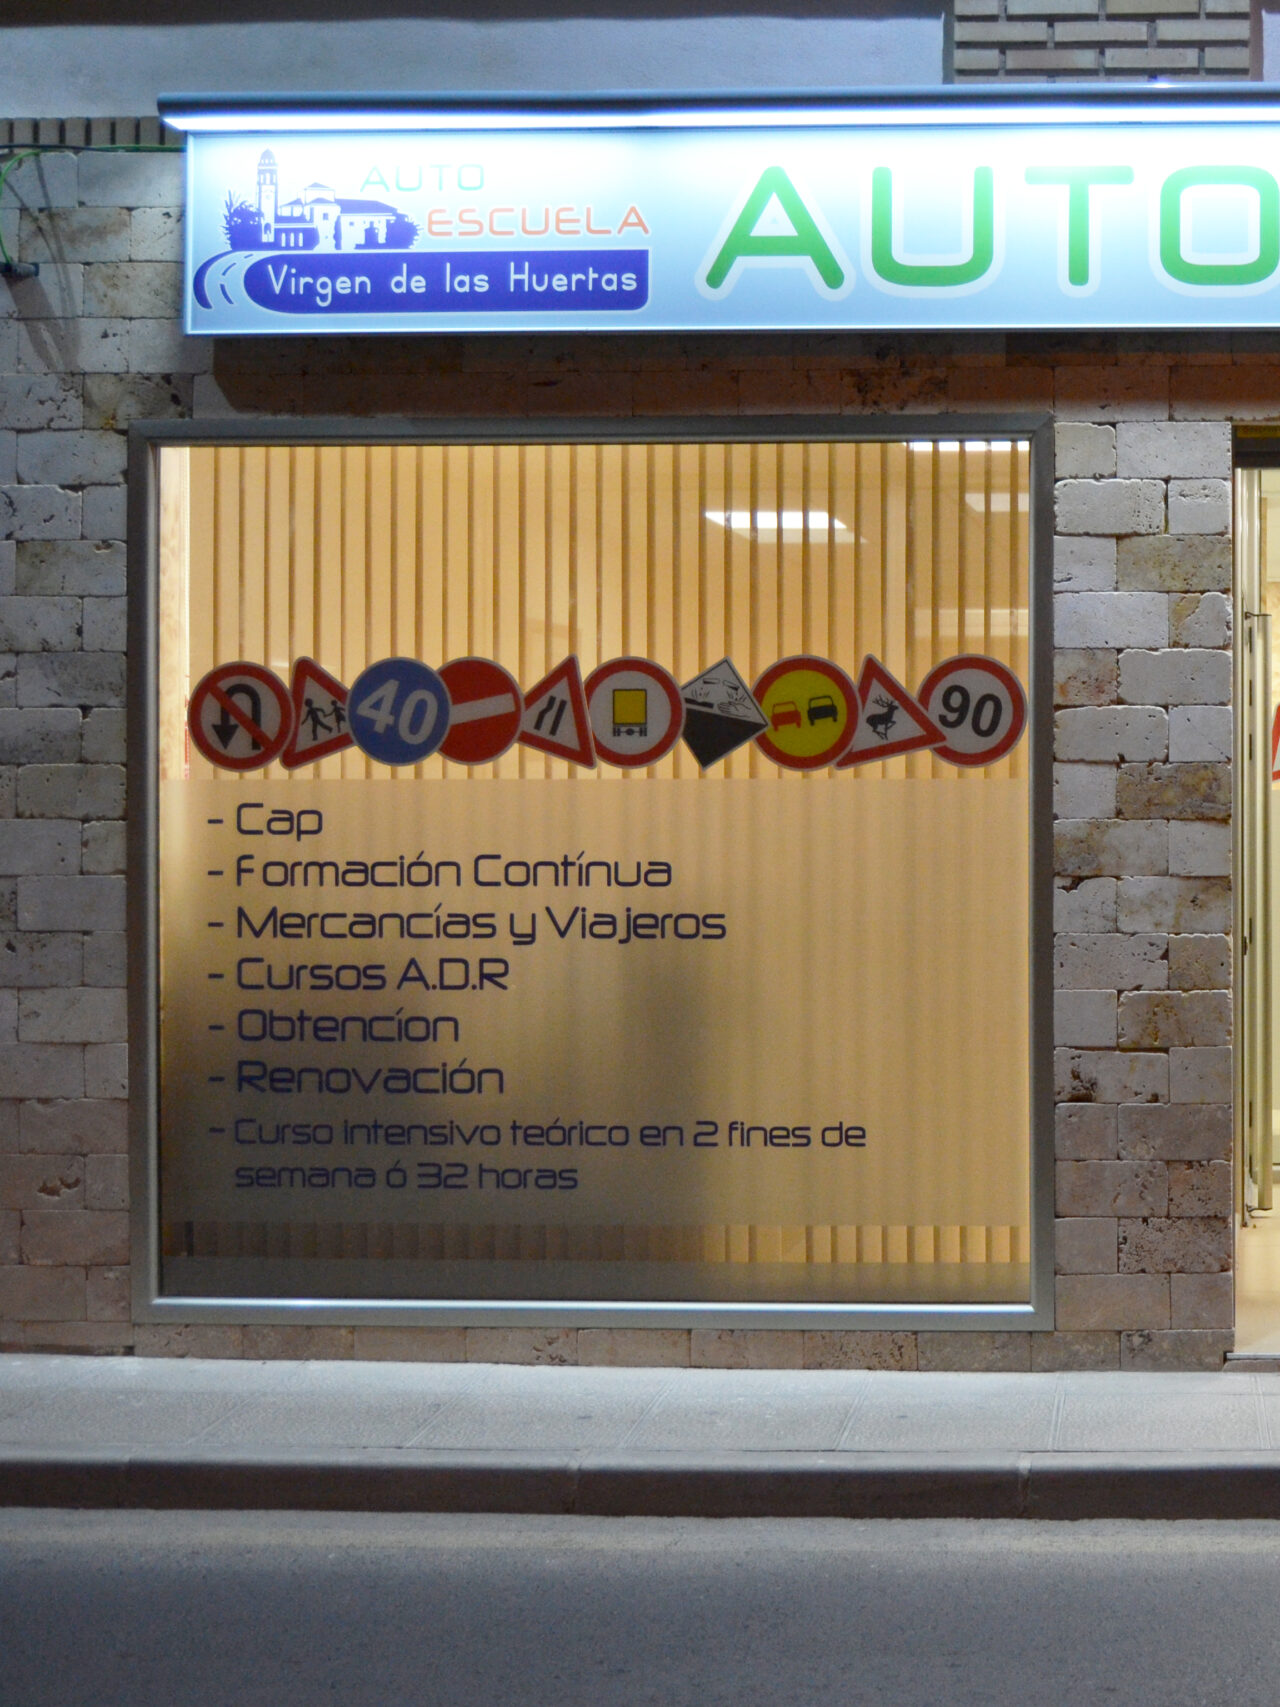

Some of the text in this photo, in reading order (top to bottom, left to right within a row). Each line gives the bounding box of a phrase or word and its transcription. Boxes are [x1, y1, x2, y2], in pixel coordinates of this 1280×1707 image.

[360, 164, 485, 192] AUTO
[427, 206, 650, 237] ESCUELA
[267, 262, 638, 307] Virgen de las Huertas
[356, 678, 439, 745] 40
[938, 684, 1003, 738] 90
[236, 802, 323, 842] Cap
[236, 850, 462, 888] Formación
[473, 850, 672, 888] Contínua
[237, 902, 497, 939] Mercancías
[509, 912, 537, 946] y
[544, 906, 727, 945] Viajeros
[236, 956, 387, 991] Cursos
[396, 957, 511, 991] A.D.R
[237, 1057, 504, 1095] Renovación
[234, 1117, 334, 1146] Curso
[343, 1119, 502, 1147] intensivo
[510, 1117, 630, 1147] teórico
[639, 1125, 684, 1147] en
[693, 1120, 719, 1148] 2
[728, 1120, 812, 1148] fines
[821, 1121, 867, 1148] de
[235, 1160, 579, 1190] semana ó 32 horas
